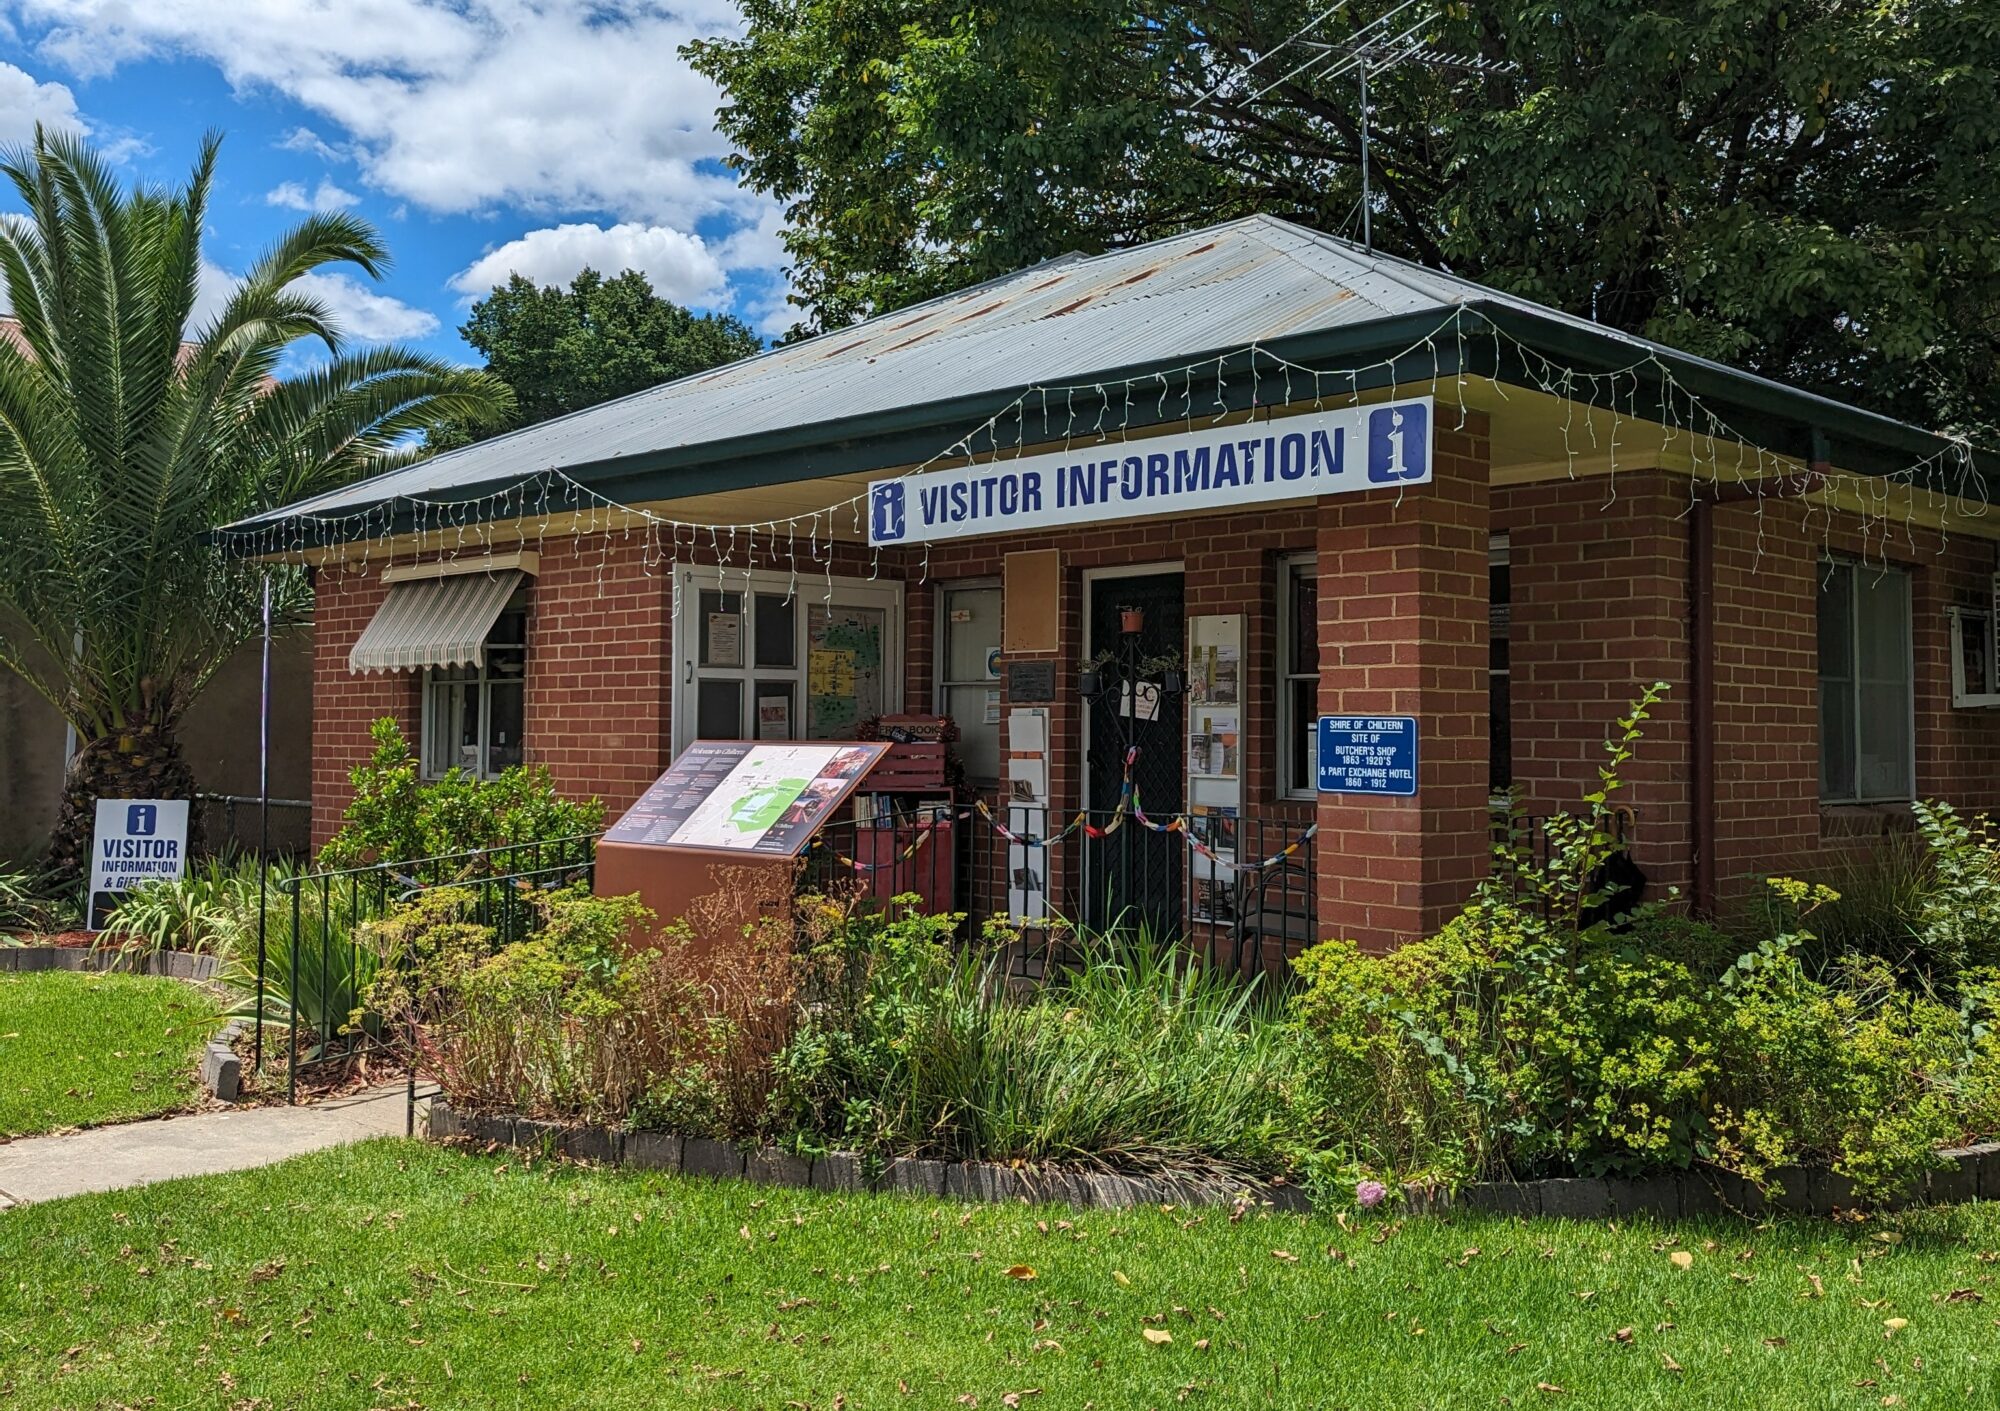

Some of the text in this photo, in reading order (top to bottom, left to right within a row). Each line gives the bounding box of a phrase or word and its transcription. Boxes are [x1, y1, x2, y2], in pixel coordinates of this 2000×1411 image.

[919, 472, 1042, 526] VISITOR
[1056, 427, 1345, 508] INFORMATION
[909, 725, 944, 735] BOOK
[1329, 720, 1403, 730] SHIRE OF CHILTERN
[1351, 734, 1380, 743] SITE OF
[1335, 745, 1396, 756] BUTCHER'S SHOP
[1342, 756, 1360, 765] 1863
[1365, 756, 1391, 766] 1920'S
[1320, 767, 1412, 779] & PART EXCHANGE HOTEL
[1345, 778, 1362, 787] 1860
[1371, 779, 1387, 788] 1912
[103, 839, 178, 858] VISITOR
[101, 860, 177, 873] INFORMATION
[104, 877, 113, 888] &
